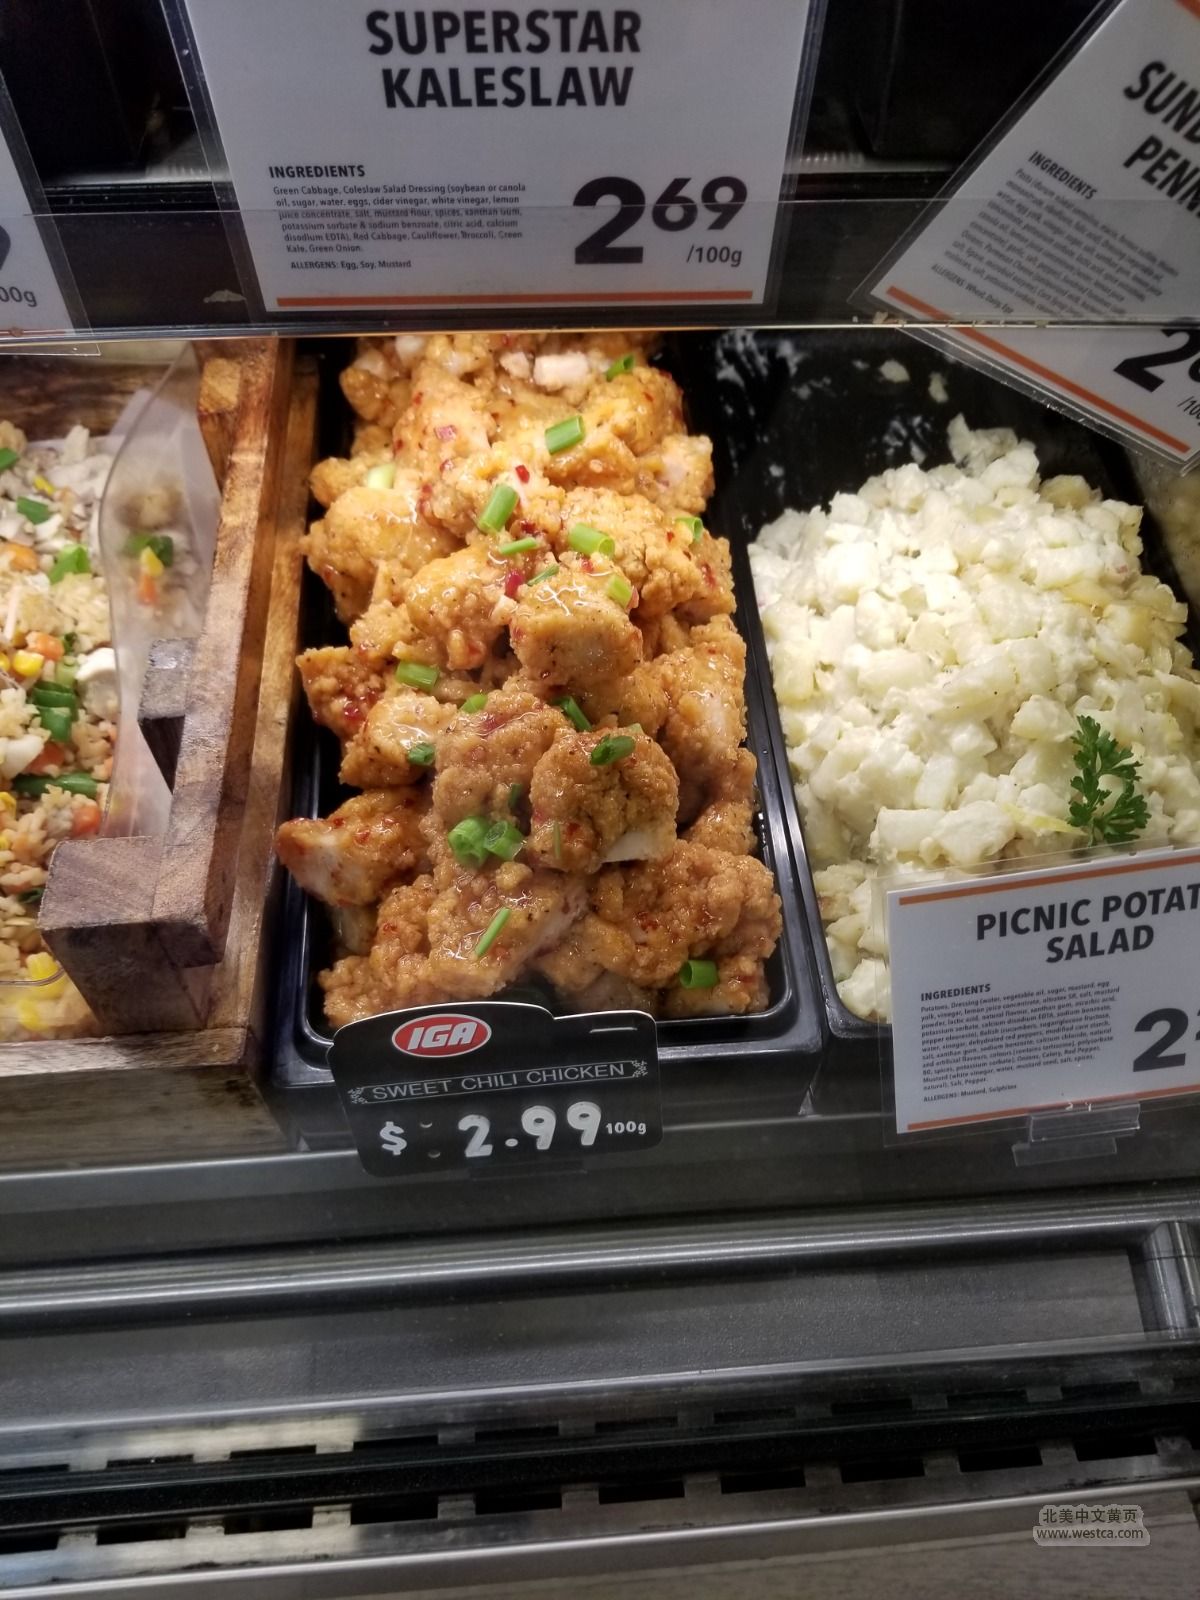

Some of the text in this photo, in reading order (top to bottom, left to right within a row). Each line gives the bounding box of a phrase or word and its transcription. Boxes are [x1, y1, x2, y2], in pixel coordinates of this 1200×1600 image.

[366, 9, 642, 56] SUPERSTAR
[381, 66, 634, 109] KALESLAW
[268, 164, 366, 178] INGREDIENTS
[1027, 150, 1098, 200] INGREDIENTS
[273, 182, 526, 196] Green Cabbage, Coleslaw Salad Dressing (soybean or canola
[347, 199, 371, 208] eggs,
[372, 197, 395, 206] cider
[432, 195, 455, 204] white
[493, 195, 520, 204] lemon
[309, 244, 333, 253] Green
[353, 232, 369, 241] Red
[378, 259, 412, 268] Mustard
[686, 245, 743, 268] /100g
[976, 882, 1200, 941] PICNIC POTAT
[1045, 924, 1155, 965] SALAD
[920, 983, 992, 1002] INGREDIENTS
[406, 1021, 478, 1051] IGA
[372, 1063, 625, 1101] SWEET CHILI CHICKEN
[379, 1101, 647, 1158] $ 2.99 100g
